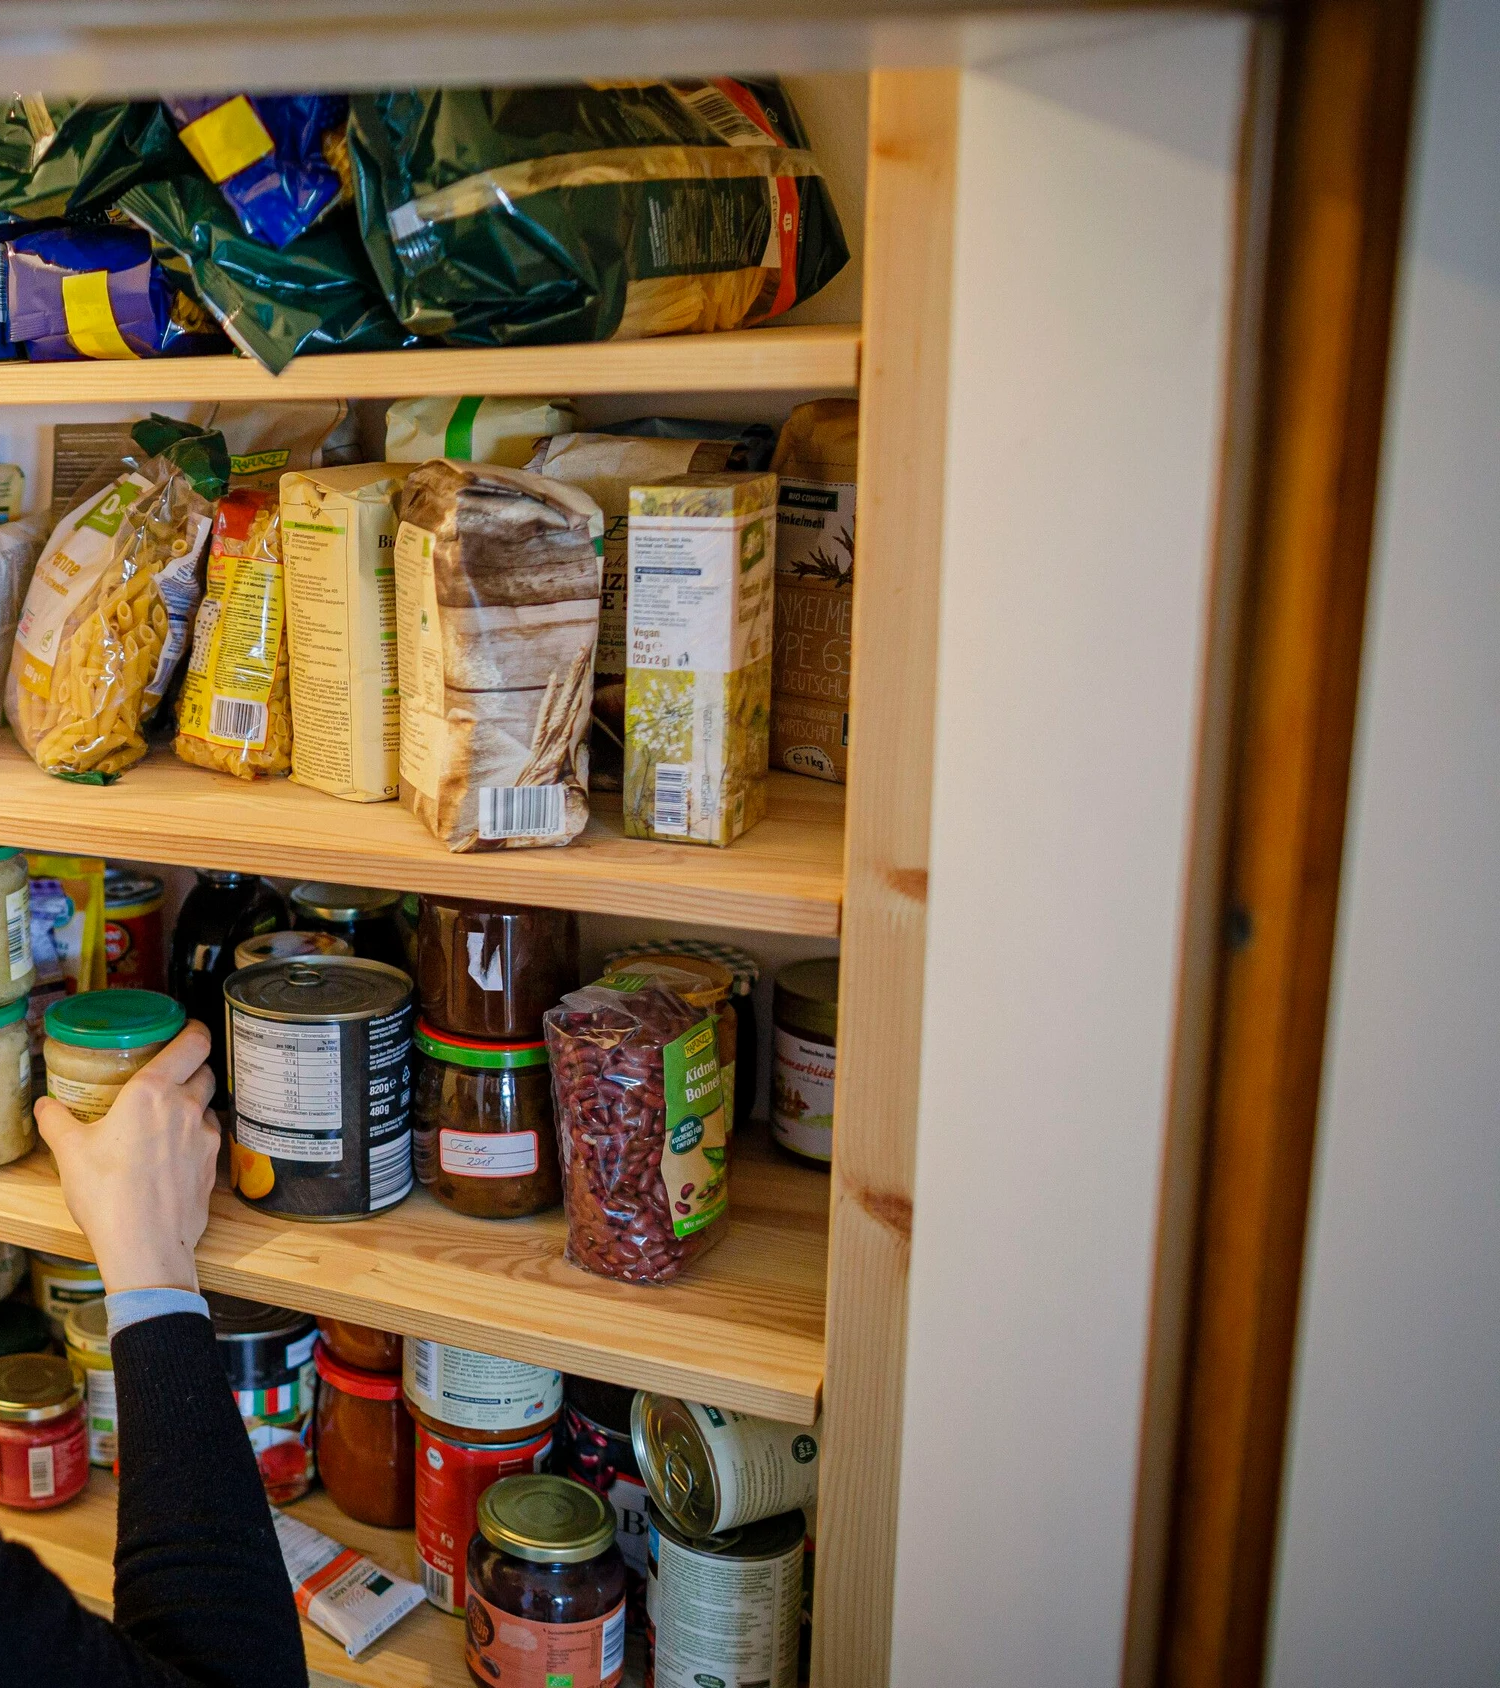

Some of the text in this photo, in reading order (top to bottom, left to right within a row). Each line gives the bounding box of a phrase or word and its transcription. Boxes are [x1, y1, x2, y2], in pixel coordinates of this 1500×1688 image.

[633, 627, 660, 639] Vegan
[633, 640, 651, 653] 40 g
[685, 1030, 713, 1055] RAPUNZEL
[369, 1104, 390, 1117] 480g
[679, 1120, 695, 1133] WEICH
[671, 1129, 694, 1145] KOCHEND
[676, 1135, 698, 1150] EINTÖPFE
[683, 1221, 695, 1230] Wir
